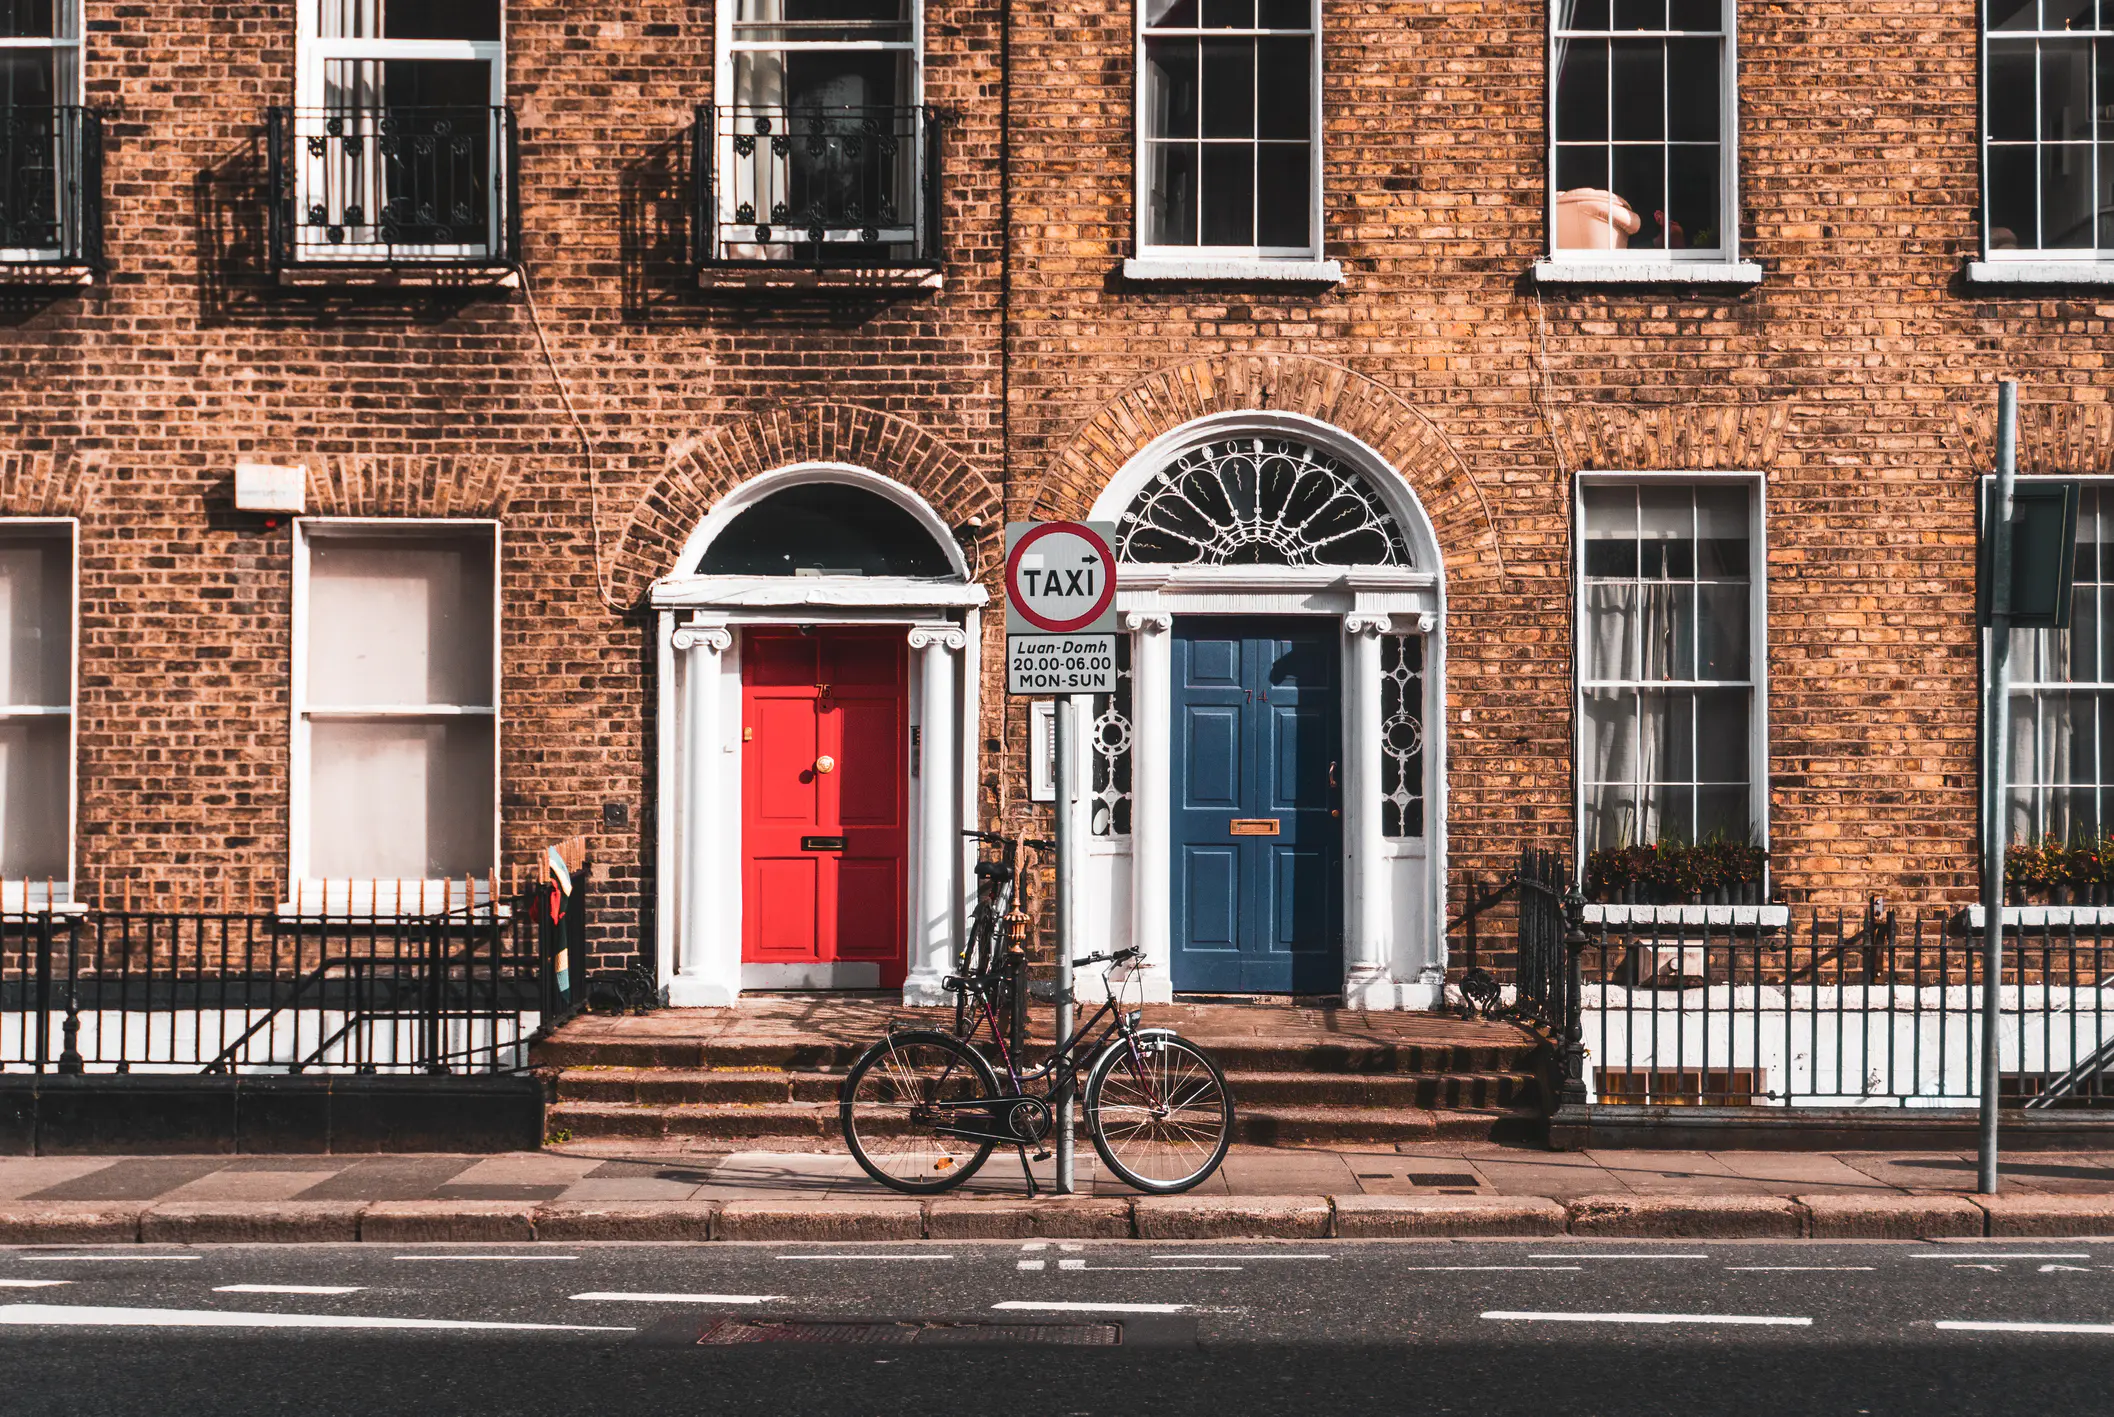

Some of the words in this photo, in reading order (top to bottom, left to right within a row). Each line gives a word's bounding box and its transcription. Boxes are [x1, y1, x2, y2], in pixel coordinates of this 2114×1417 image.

[1023, 569, 1094, 597] TAXI
[1017, 641, 1108, 655] Luan-Domh
[1013, 657, 1112, 671] 20.00-06.00
[1019, 674, 1106, 688] MON-SUN
[815, 683, 831, 699] 75
[1244, 689, 1268, 704] 74
